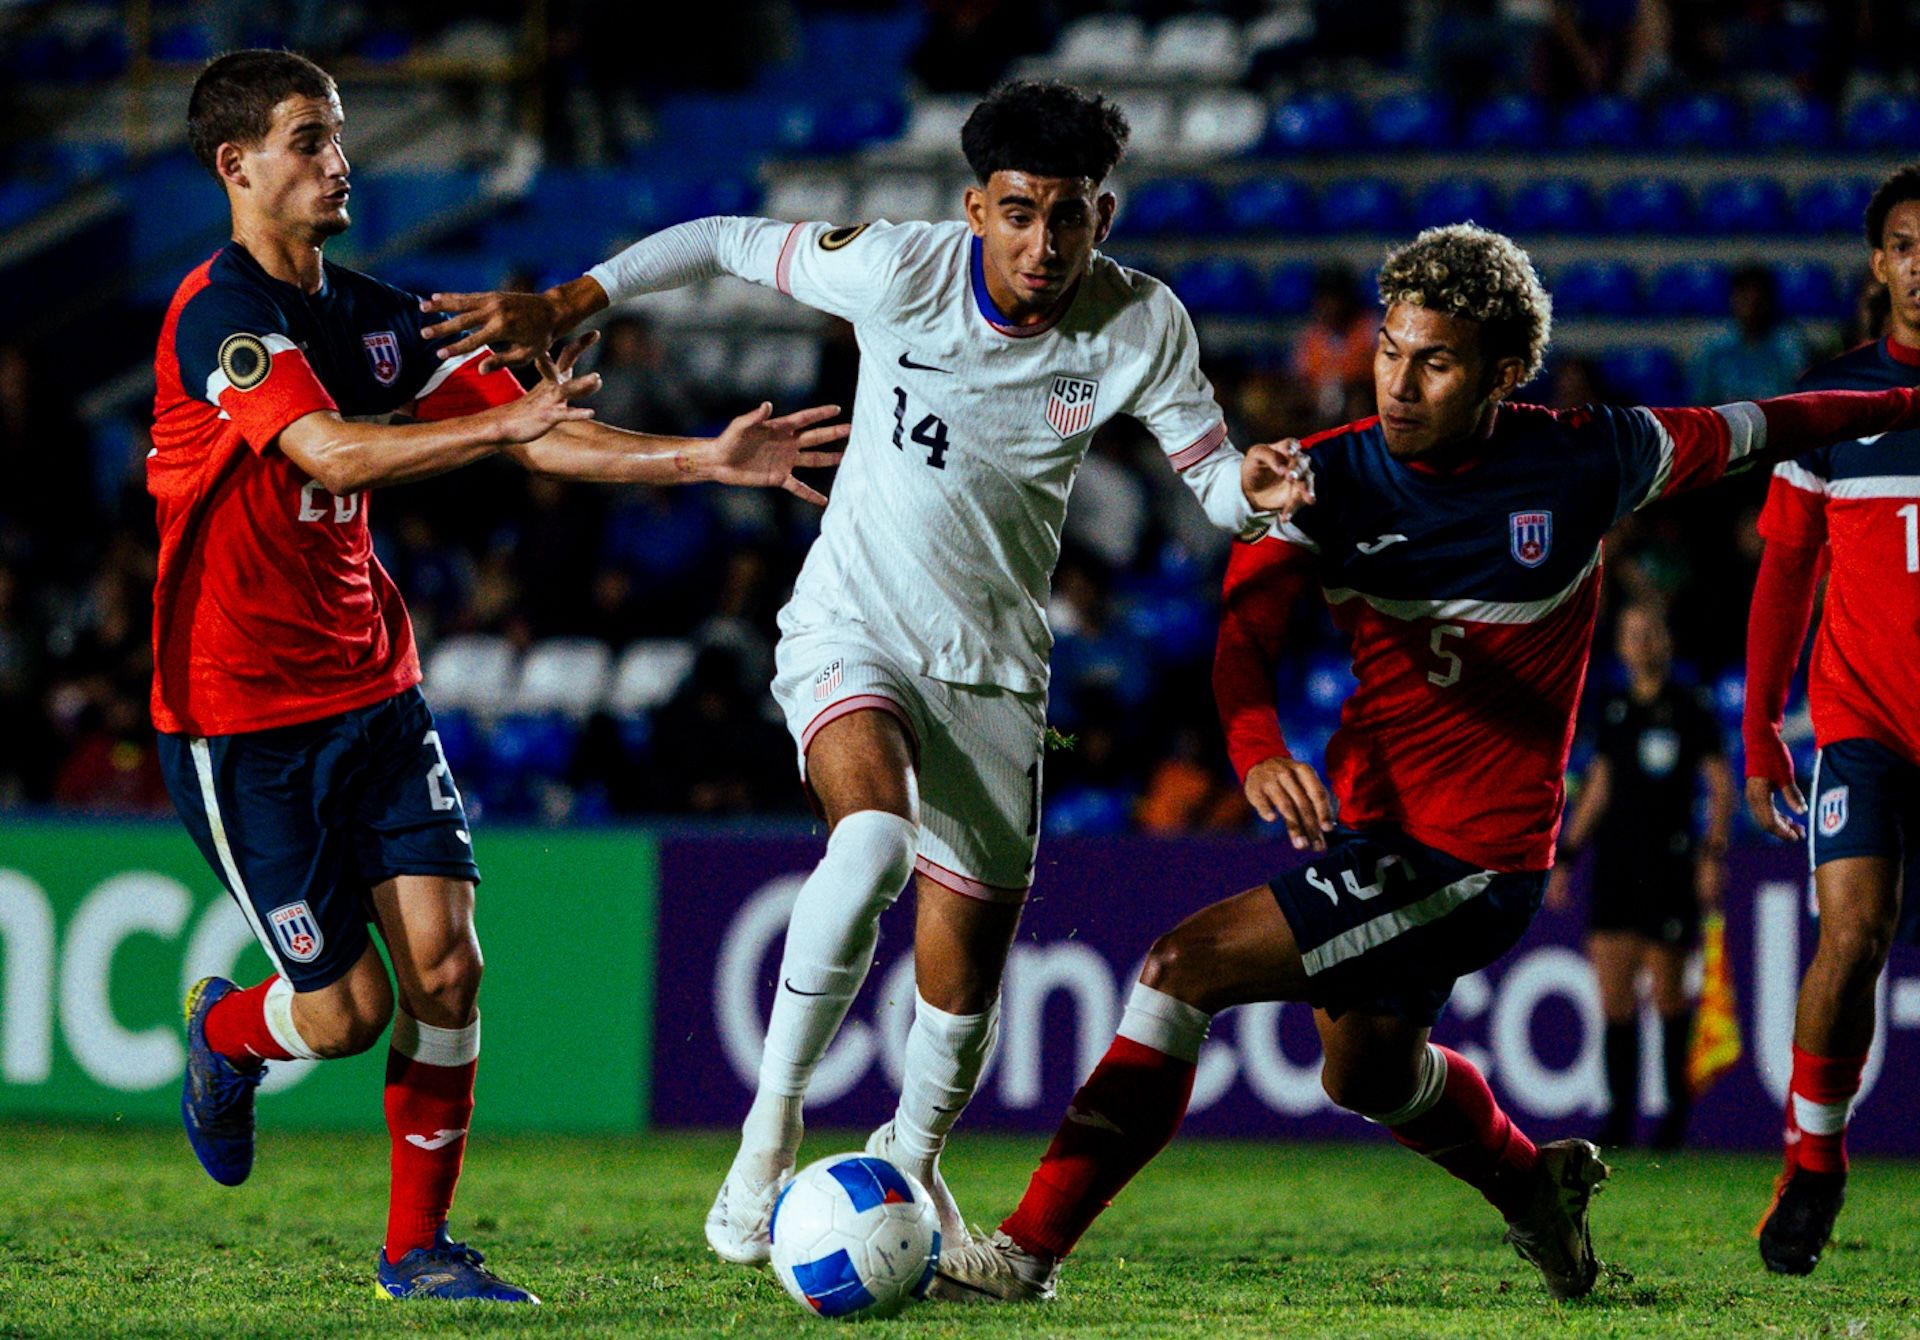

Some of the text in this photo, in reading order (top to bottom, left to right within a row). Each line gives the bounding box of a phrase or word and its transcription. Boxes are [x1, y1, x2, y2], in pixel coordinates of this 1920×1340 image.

[1054, 378, 1095, 404] USA
[892, 385, 951, 471] 14
[1516, 514, 1546, 526] CUBA
[1895, 503, 1920, 573] 1
[816, 661, 840, 684] USA
[1427, 624, 1466, 688] 5
[422, 729, 464, 811] 2
[275, 906, 304, 924] CUBA
